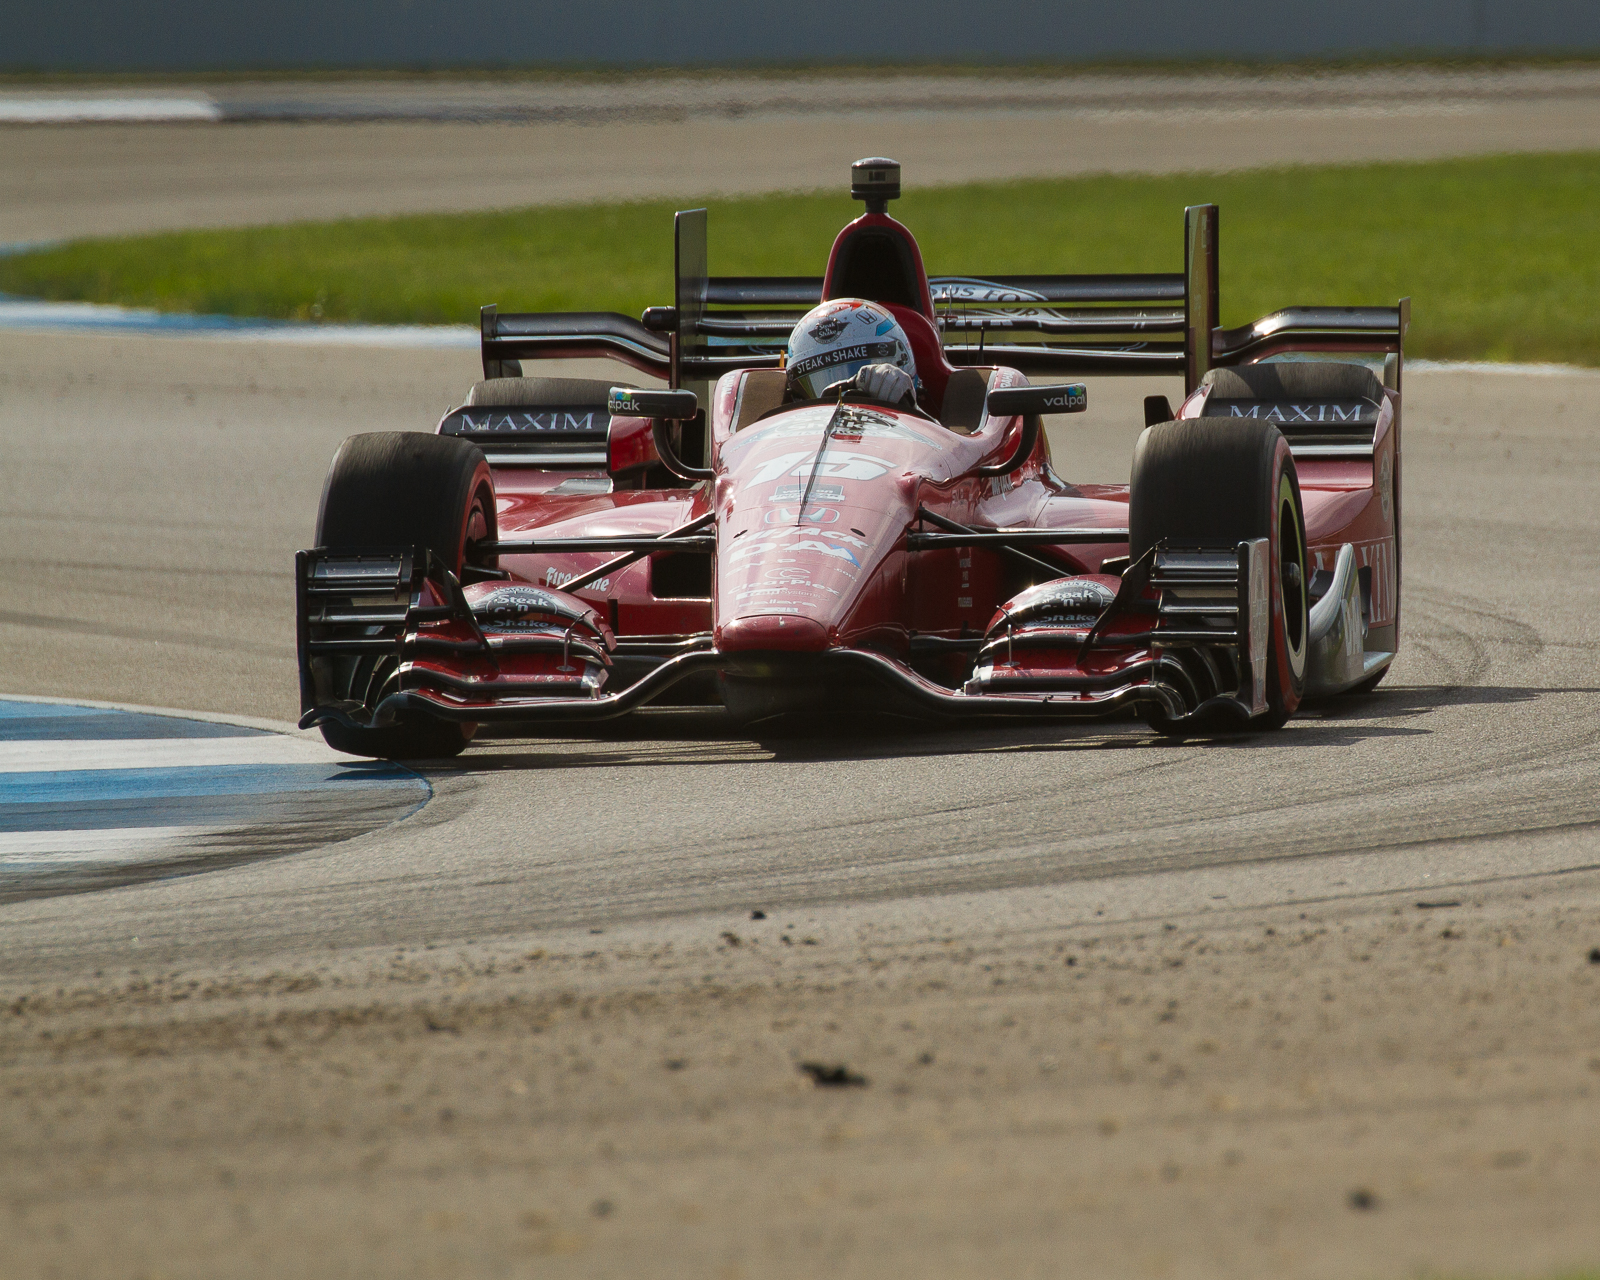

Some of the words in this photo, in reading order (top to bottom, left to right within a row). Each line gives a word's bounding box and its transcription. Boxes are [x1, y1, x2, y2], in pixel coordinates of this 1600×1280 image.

[796, 356, 824, 374] STEAK
[825, 354, 831, 362] N
[832, 346, 868, 362] SHAKE
[460, 412, 594, 431] MAXIM
[1230, 404, 1363, 422] MAXIM
[743, 450, 900, 490] 15
[546, 567, 609, 592] Firene
[497, 594, 548, 607] Steak
[1043, 589, 1094, 601] Steak
